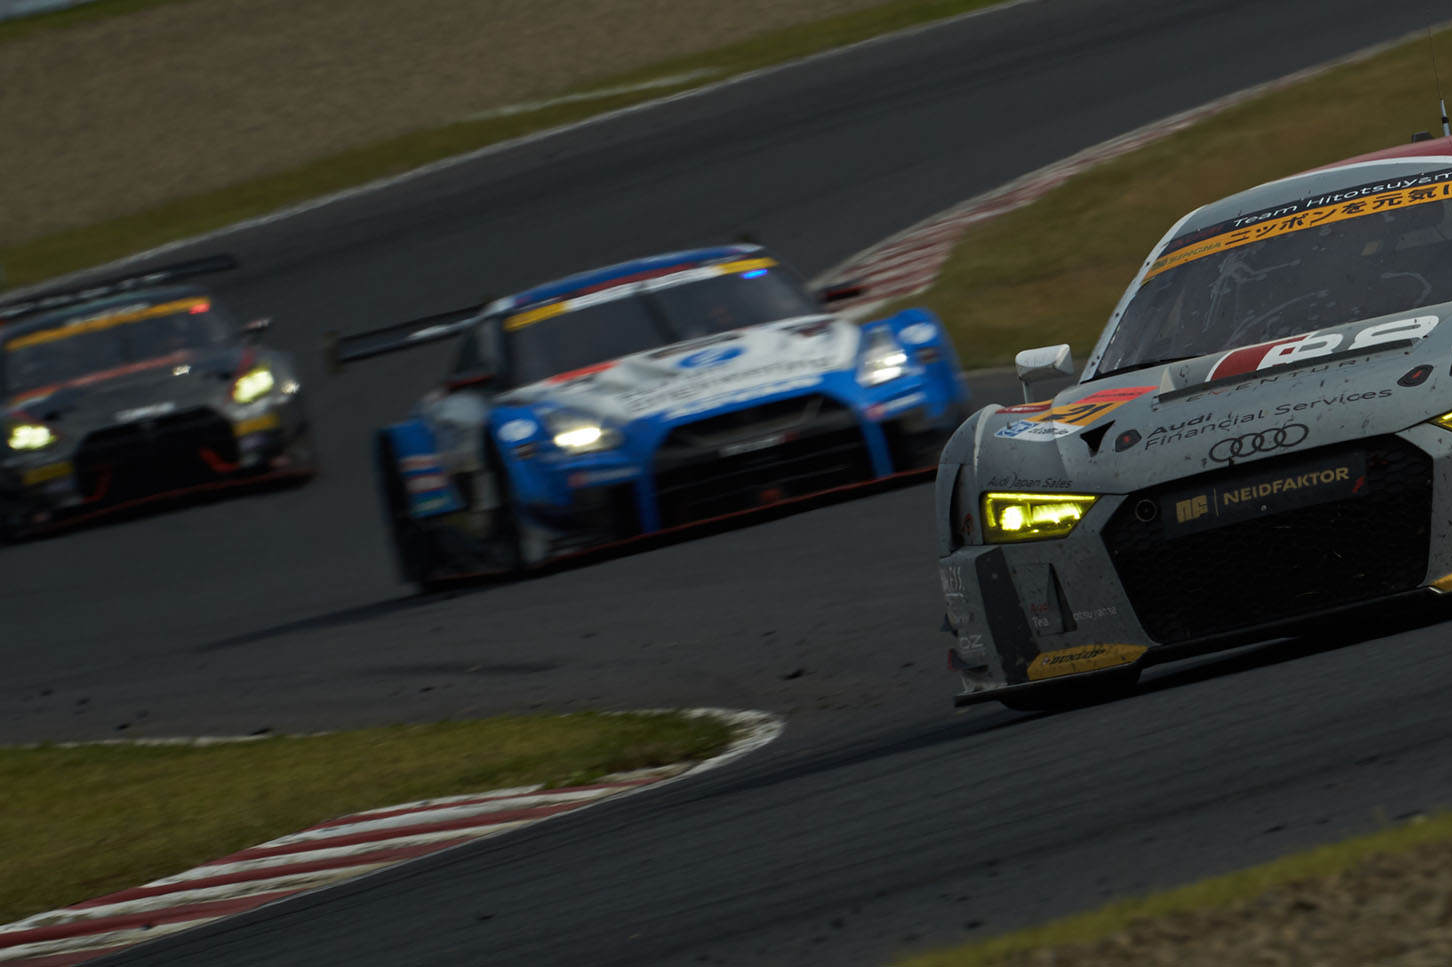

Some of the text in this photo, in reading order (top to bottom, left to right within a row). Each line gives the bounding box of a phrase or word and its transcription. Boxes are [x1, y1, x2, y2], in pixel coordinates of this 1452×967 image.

[1234, 205, 1298, 228] Team
[1145, 387, 1393, 451] Financial Services
[1146, 412, 1213, 436] Audi
[1223, 467, 1350, 505] NEIDFAKTOR
